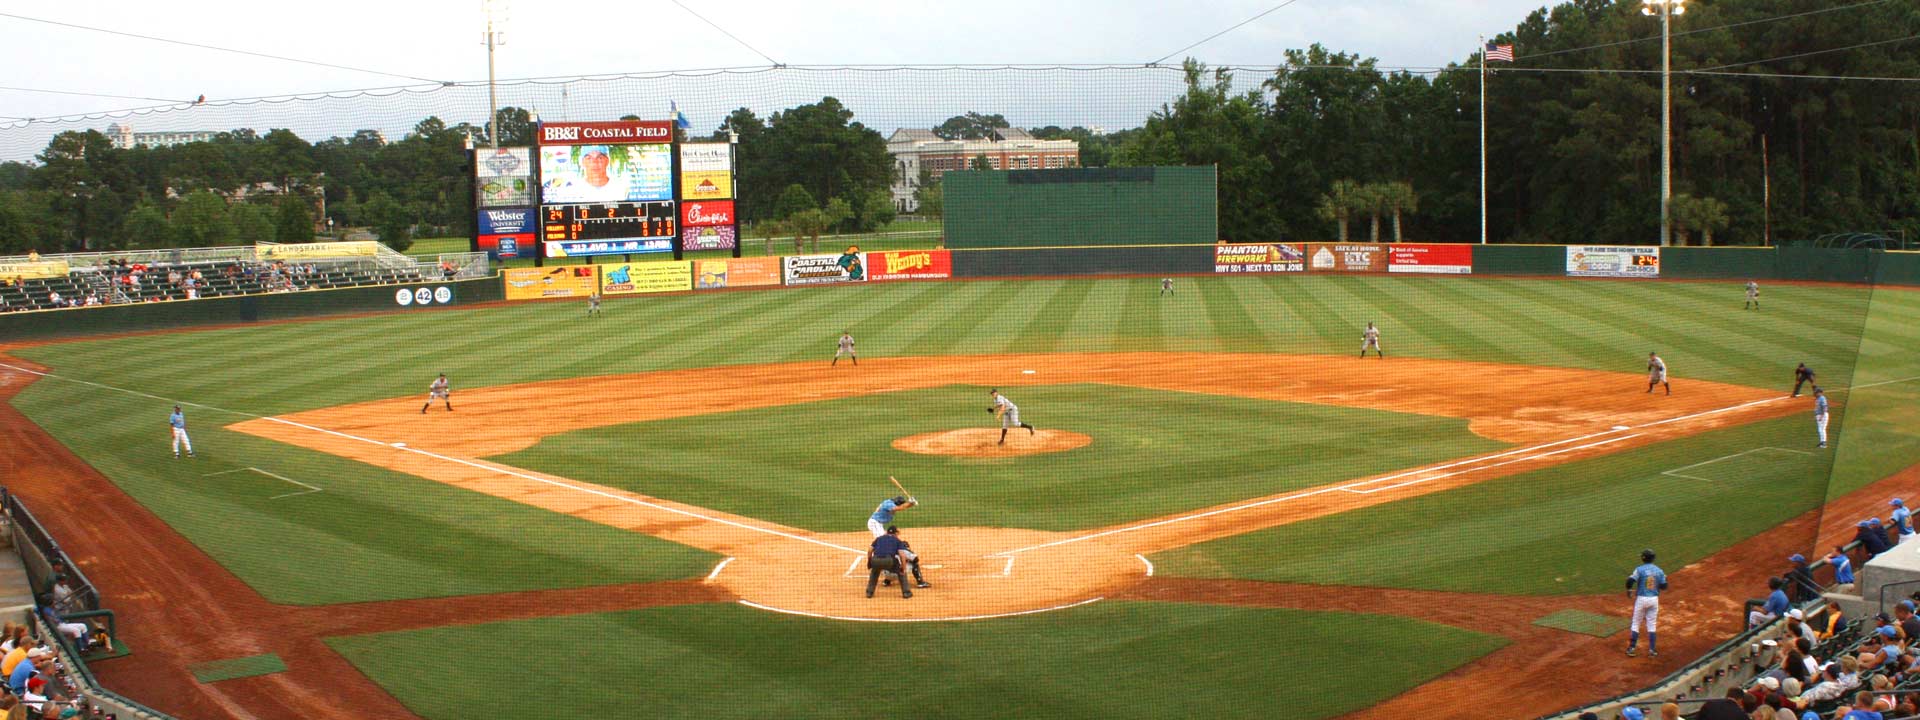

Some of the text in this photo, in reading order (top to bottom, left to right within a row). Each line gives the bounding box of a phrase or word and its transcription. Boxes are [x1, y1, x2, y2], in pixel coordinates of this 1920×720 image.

[544, 126, 668, 141] BB&T COASTAL FIELD
[487, 210, 526, 221] Webster
[550, 210, 563, 220] 24
[581, 209, 588, 219] 0
[608, 208, 615, 218] 2
[1217, 245, 1268, 254] PHANTOM
[789, 257, 836, 269] COASTAL
[1216, 254, 1267, 263] FIREWORKS
[790, 265, 843, 278] CAROLINA
[417, 291, 431, 300] 42
